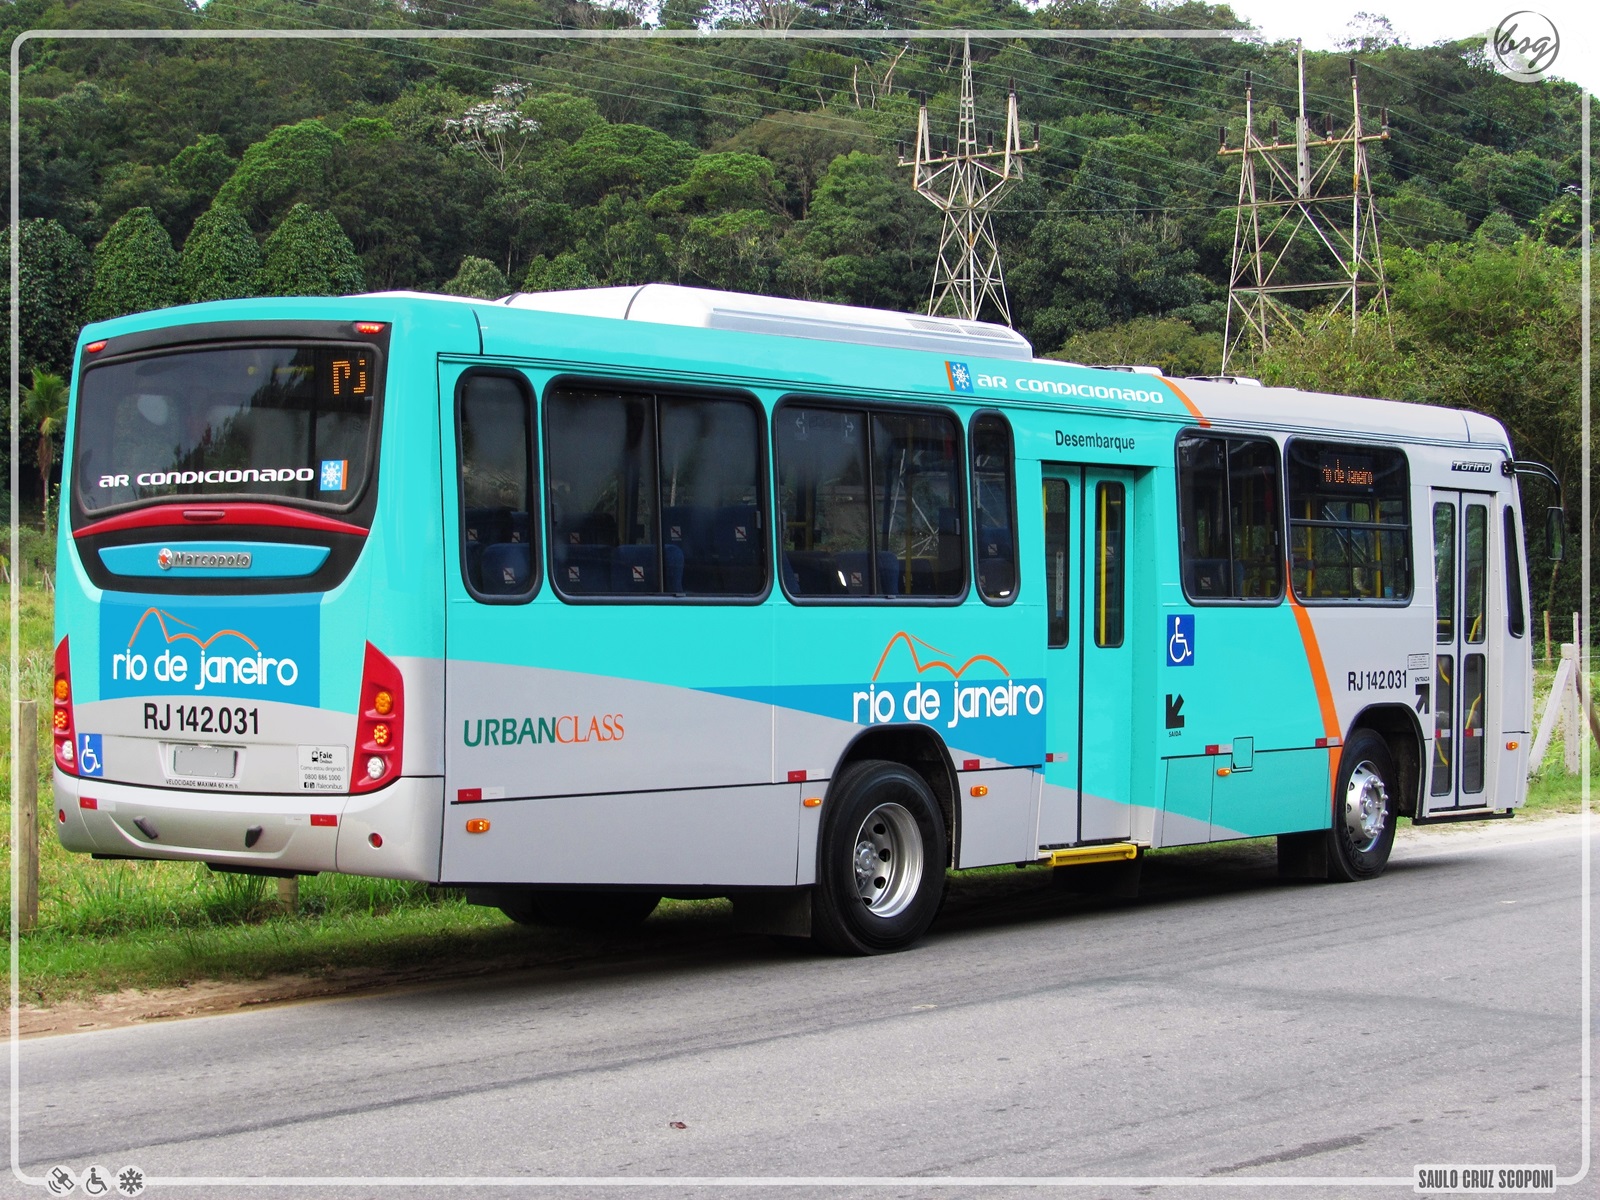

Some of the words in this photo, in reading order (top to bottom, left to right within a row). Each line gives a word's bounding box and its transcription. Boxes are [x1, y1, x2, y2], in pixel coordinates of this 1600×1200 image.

[1055, 429, 1136, 453] Desembarque
[173, 551, 250, 567] Marcopolo
[112, 648, 148, 681] rio
[153, 649, 188, 682] de
[194, 650, 299, 690] janeiro
[1348, 670, 1364, 692] RJ
[1365, 669, 1407, 691] 142.031
[852, 683, 896, 723] rio
[903, 682, 940, 721] de
[947, 679, 1044, 728] janeiro
[144, 702, 171, 731] RJ
[176, 704, 259, 735] 142.031
[319, 751, 333, 759] Fale
[166, 778, 196, 787] VELOCIDADE
